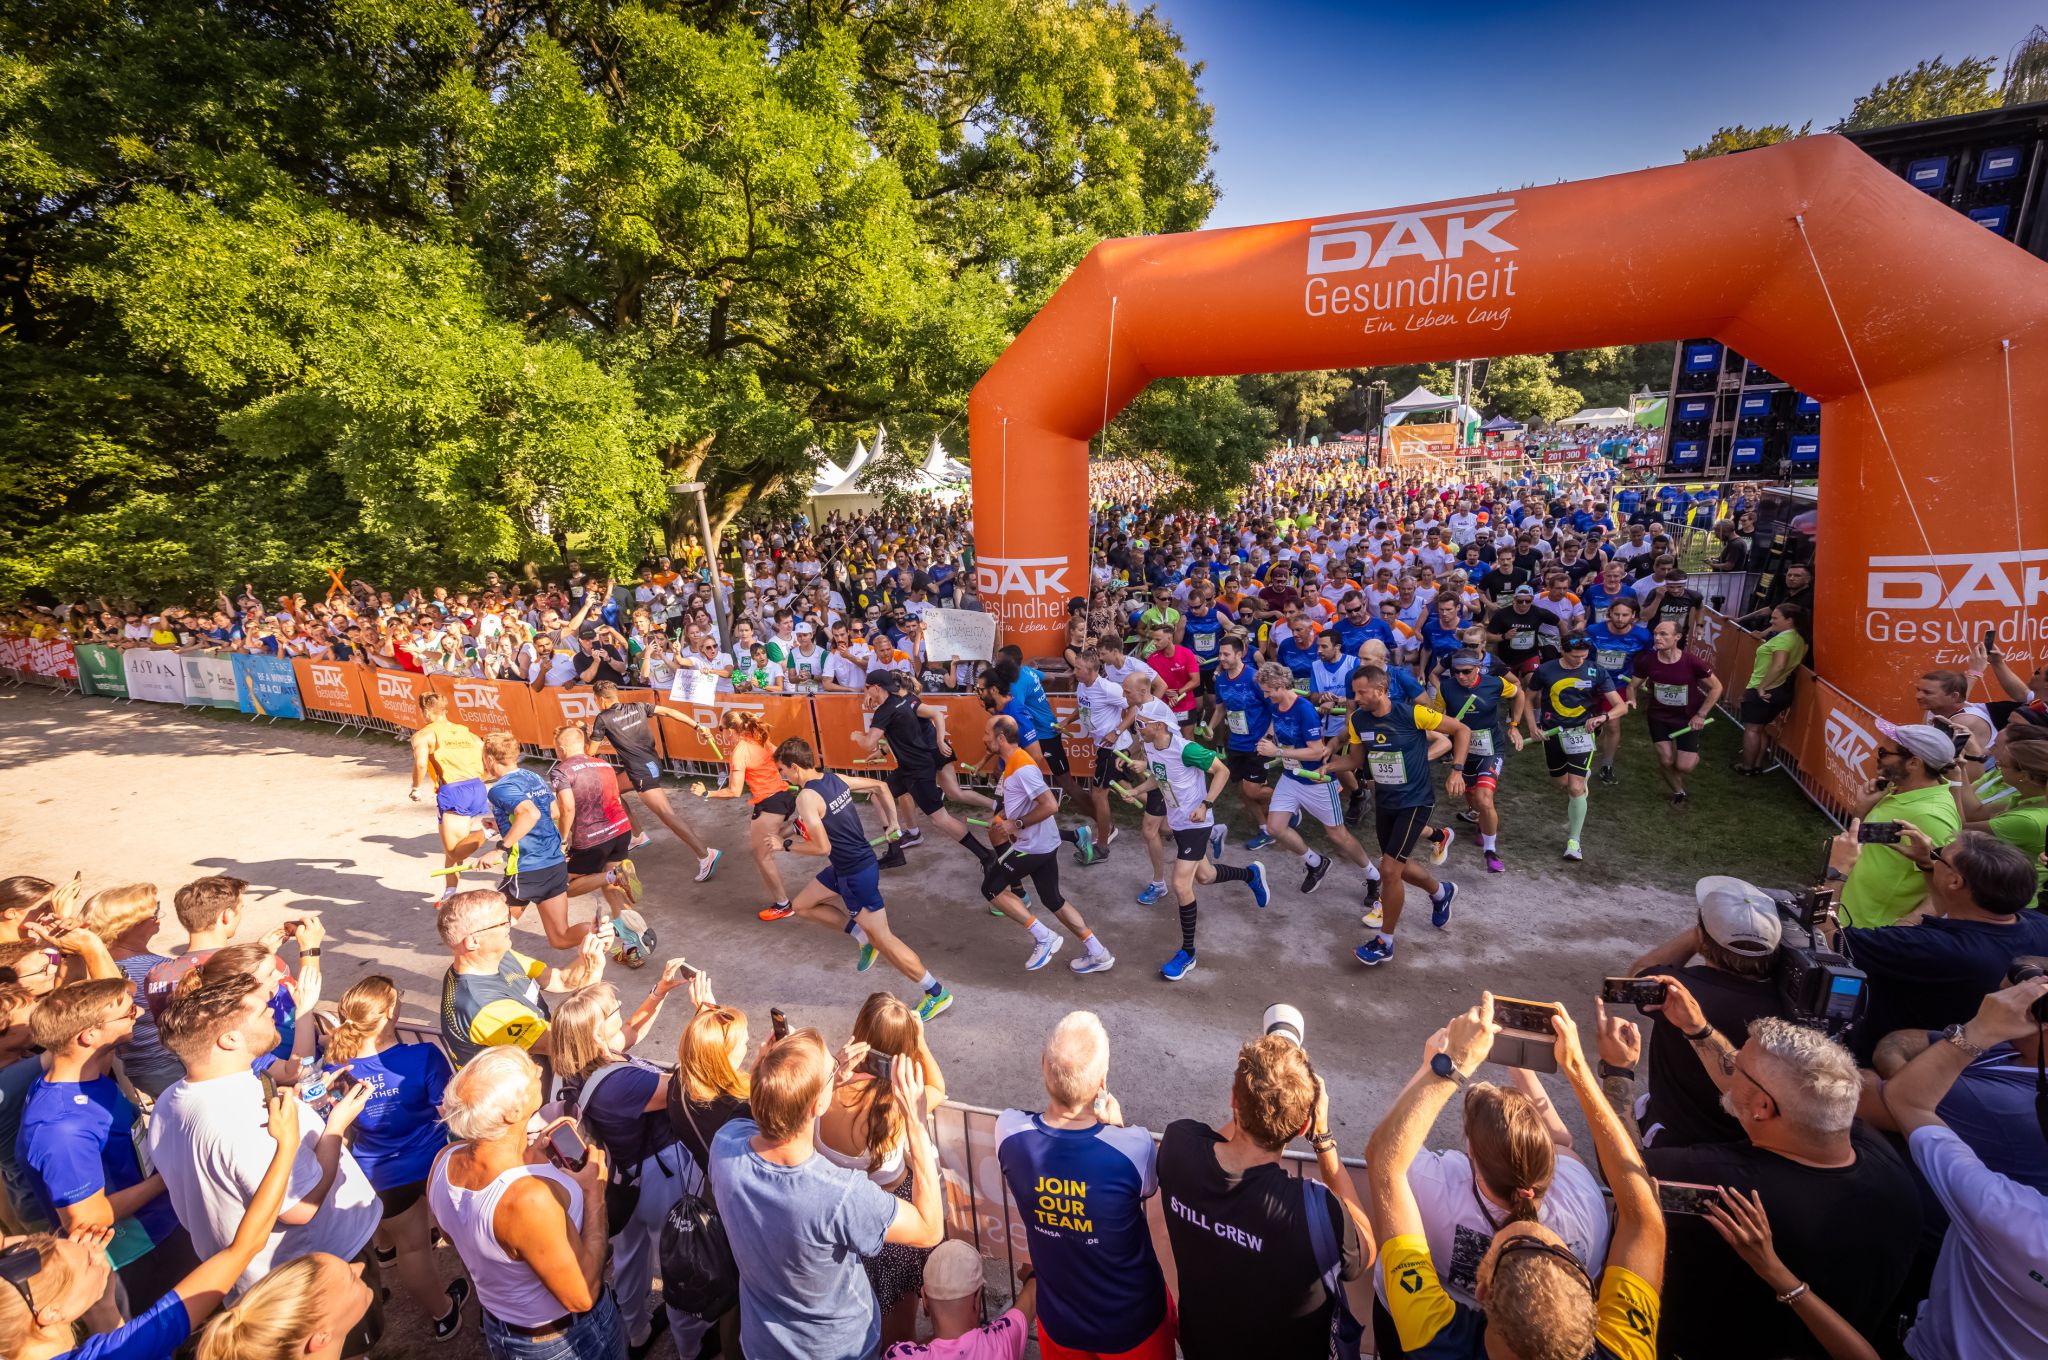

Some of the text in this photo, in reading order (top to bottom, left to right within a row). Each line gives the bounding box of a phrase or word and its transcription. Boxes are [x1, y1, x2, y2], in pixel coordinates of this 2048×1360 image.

[1307, 199, 1520, 275] DAK
[1305, 257, 1519, 317] Gesundheit
[1364, 317, 1397, 334] Ein
[1405, 309, 1458, 331] Leben
[1548, 451, 1580, 460] 201 300
[976, 556, 1071, 596] DAK
[1668, 606, 1689, 614] KHS
[1020, 621, 1048, 633] Leben
[310, 665, 345, 688] DAK
[377, 673, 415, 700] DAK
[453, 684, 505, 712] DAK
[558, 692, 601, 718] DA
[1664, 691, 1678, 699] 267
[1569, 735, 1584, 745] 332
[1825, 708, 1879, 785] DAK
[1378, 763, 1394, 774] 335
[1034, 1176, 1086, 1198] JOIN
[1039, 1195, 1085, 1217] OUR
[1034, 1209, 1093, 1233] TEAM
[1034, 1225, 1061, 1238] HANSA
[1170, 1195, 1262, 1252] STILL CREW
